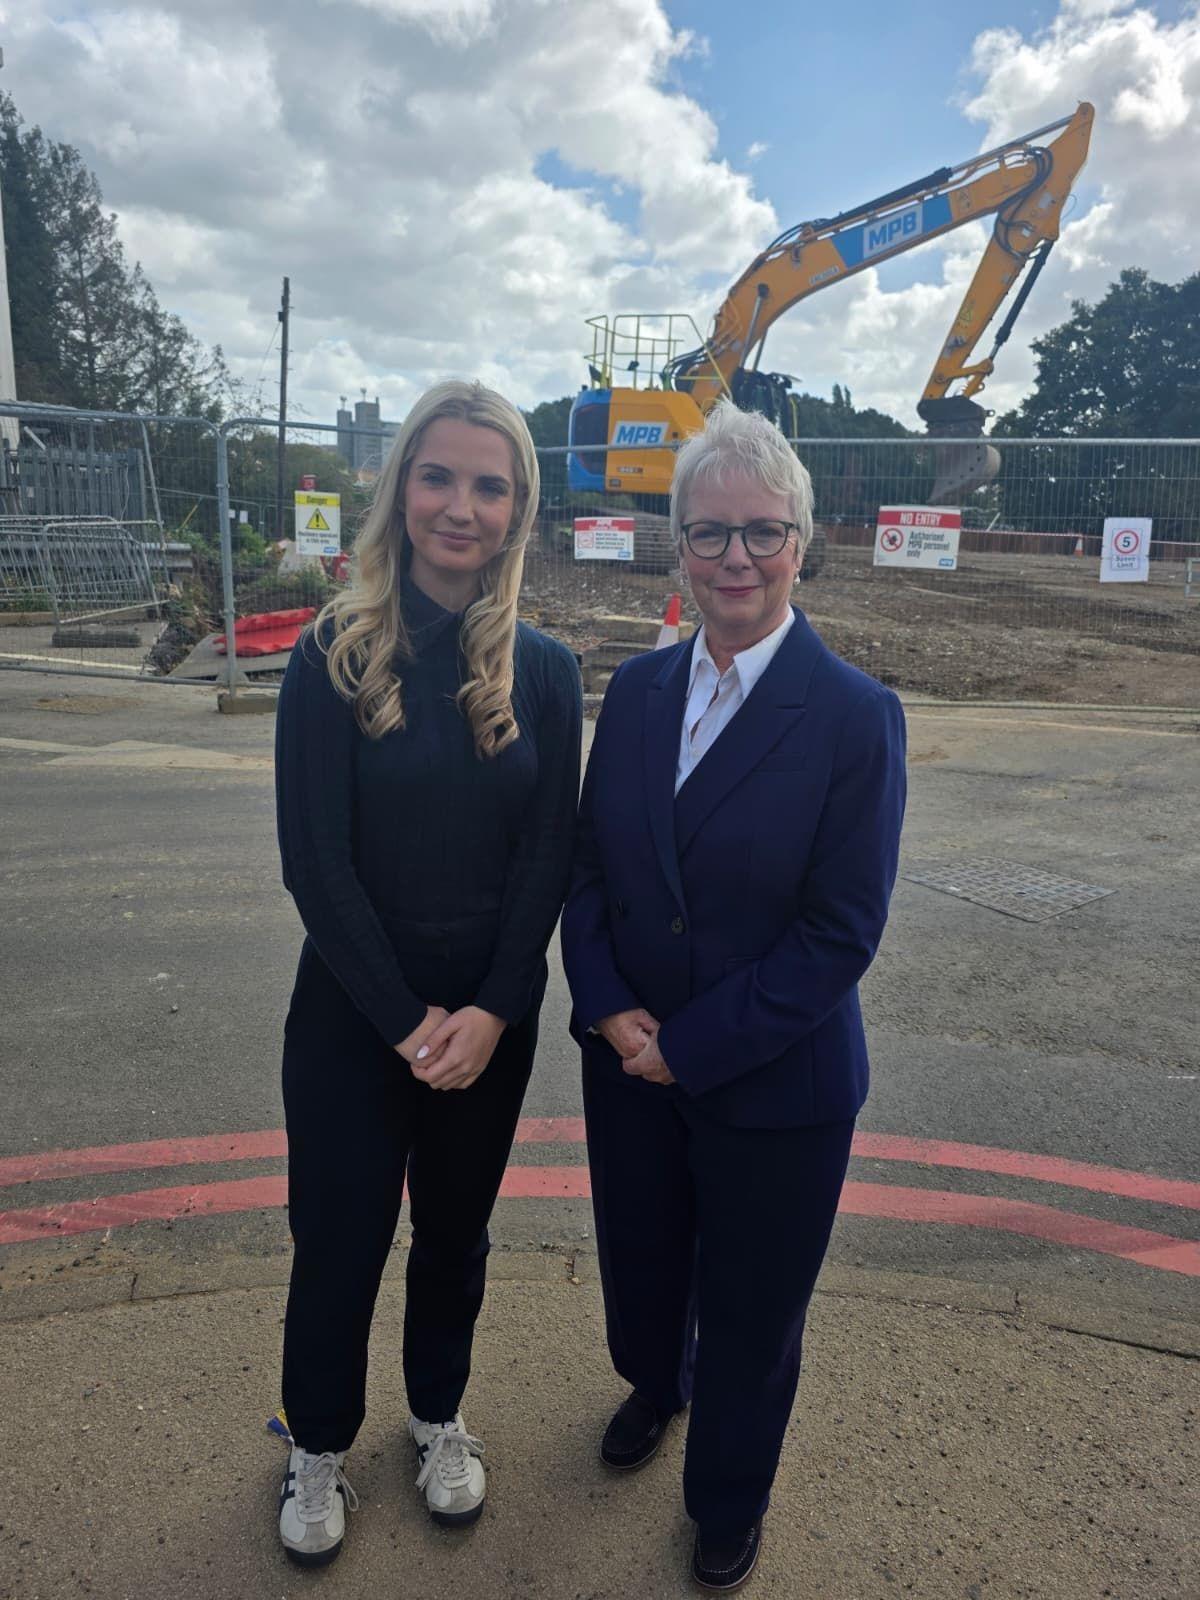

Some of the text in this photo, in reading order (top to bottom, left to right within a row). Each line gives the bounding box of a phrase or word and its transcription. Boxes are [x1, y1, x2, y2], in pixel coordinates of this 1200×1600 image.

[869, 211, 917, 250] MPB
[616, 425, 662, 444] MPB
[900, 512, 942, 526] NO ENTRY
[1122, 536, 1131, 548] 5
